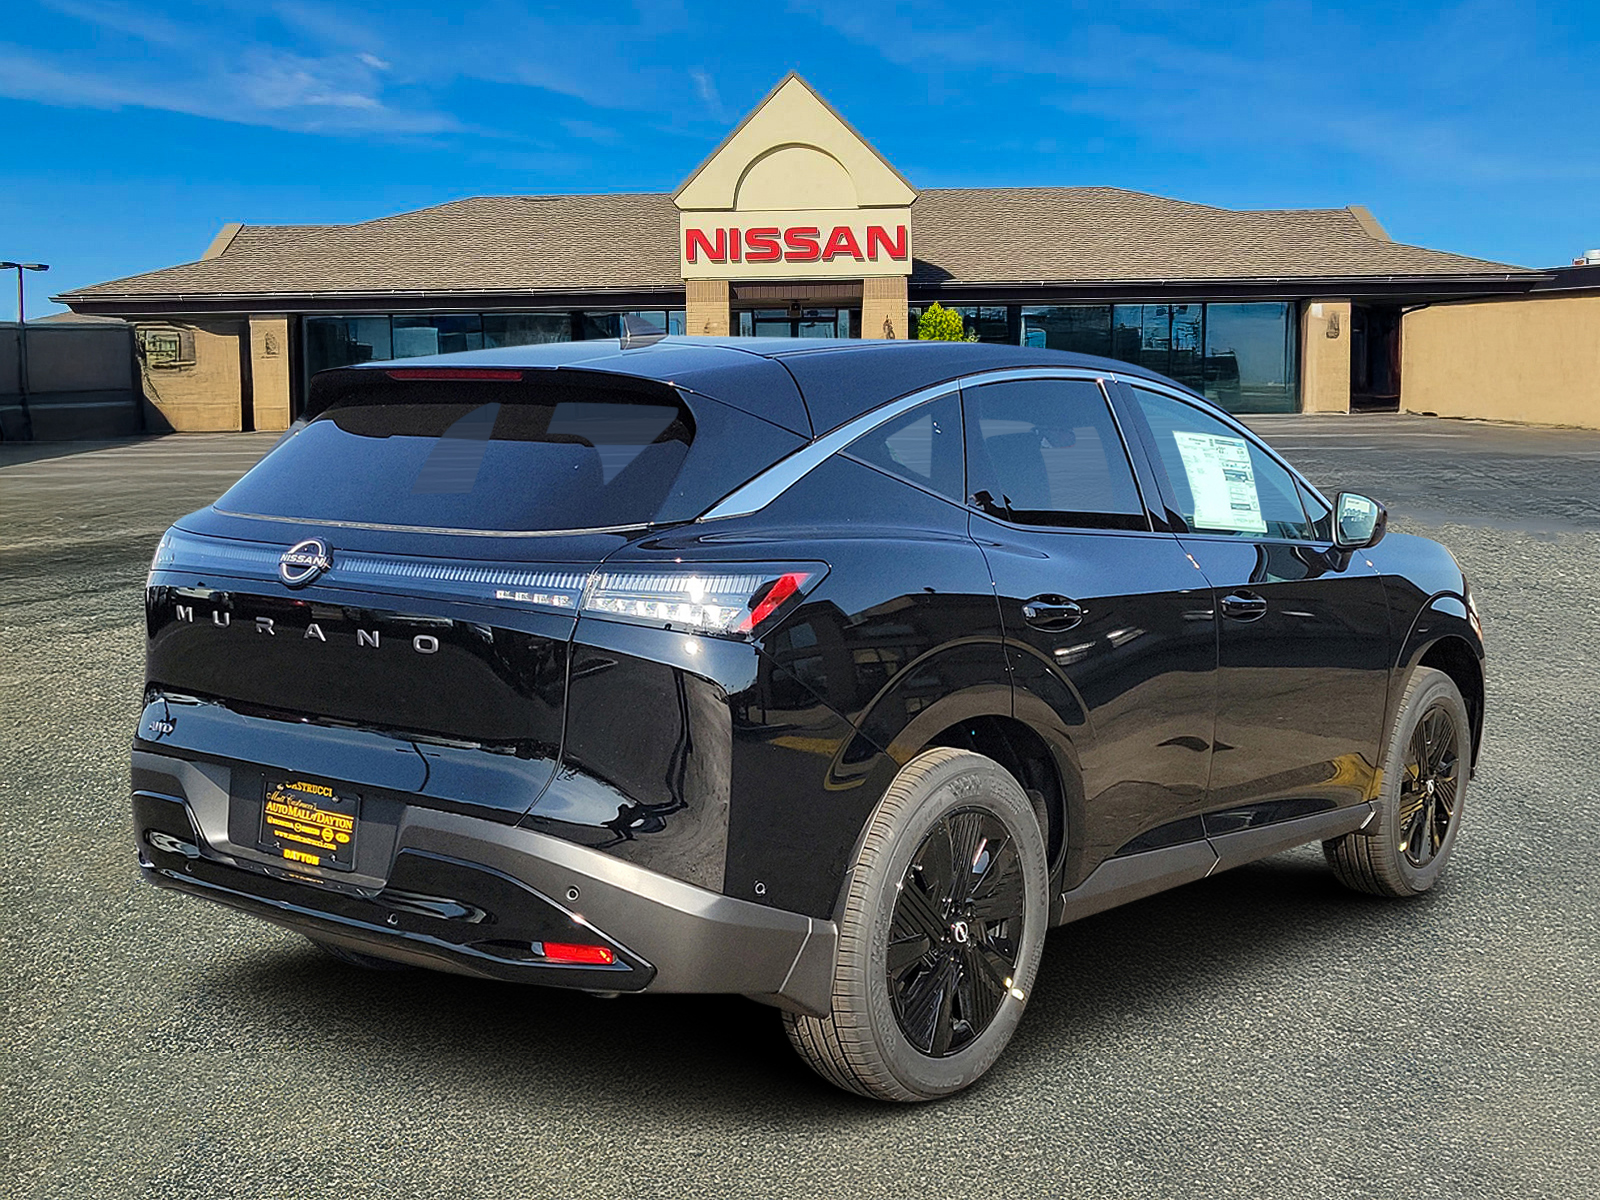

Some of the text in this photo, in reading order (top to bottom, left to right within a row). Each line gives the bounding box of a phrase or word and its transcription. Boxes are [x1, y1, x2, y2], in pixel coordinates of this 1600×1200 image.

[685, 225, 908, 263] NISSAN
[280, 554, 325, 567] NISSAN
[176, 605, 439, 654] MURANO
[285, 781, 333, 797] CASTRUCCI
[316, 812, 353, 830] DAYTON
[283, 848, 320, 866] DAYTON
